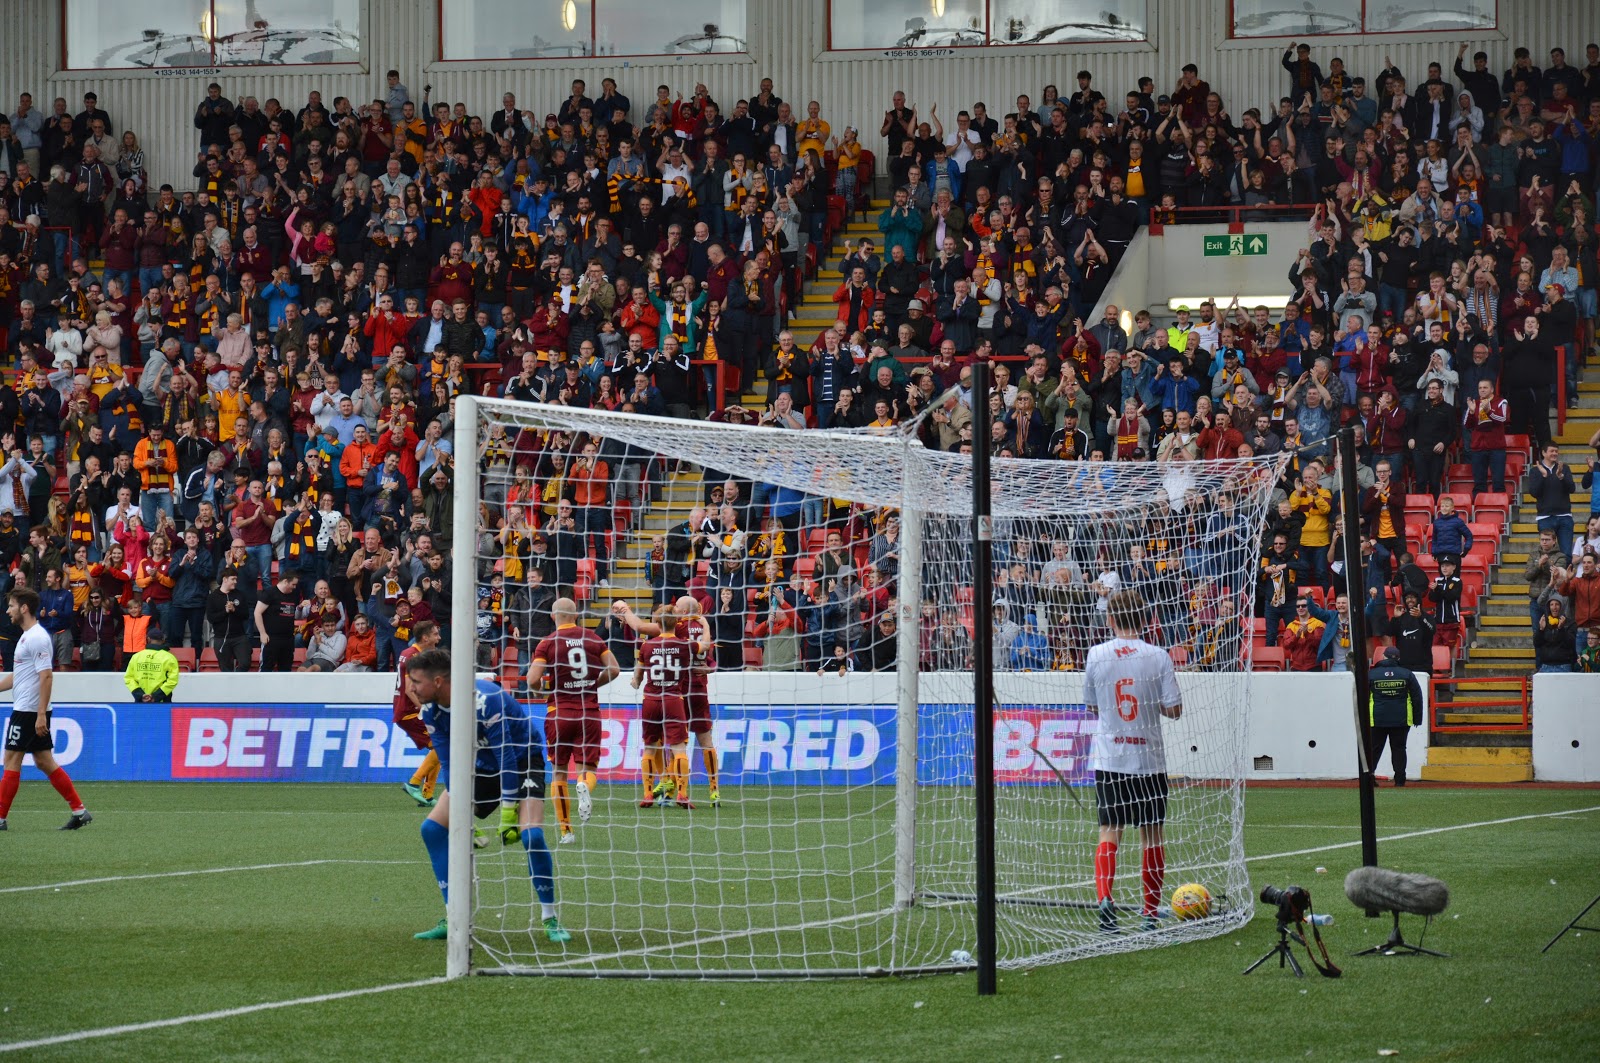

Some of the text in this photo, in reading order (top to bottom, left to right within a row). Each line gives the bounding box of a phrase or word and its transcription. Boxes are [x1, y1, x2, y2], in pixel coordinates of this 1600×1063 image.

[1206, 241, 1223, 250] Exit
[565, 639, 583, 648] MAIN
[652, 647, 680, 655] JOHNSON
[567, 647, 588, 679] 9
[649, 654, 682, 680] 24
[1115, 678, 1139, 723] 6
[8, 724, 21, 740] 15
[184, 717, 428, 768] BETFRE
[598, 719, 880, 770] BFRED
